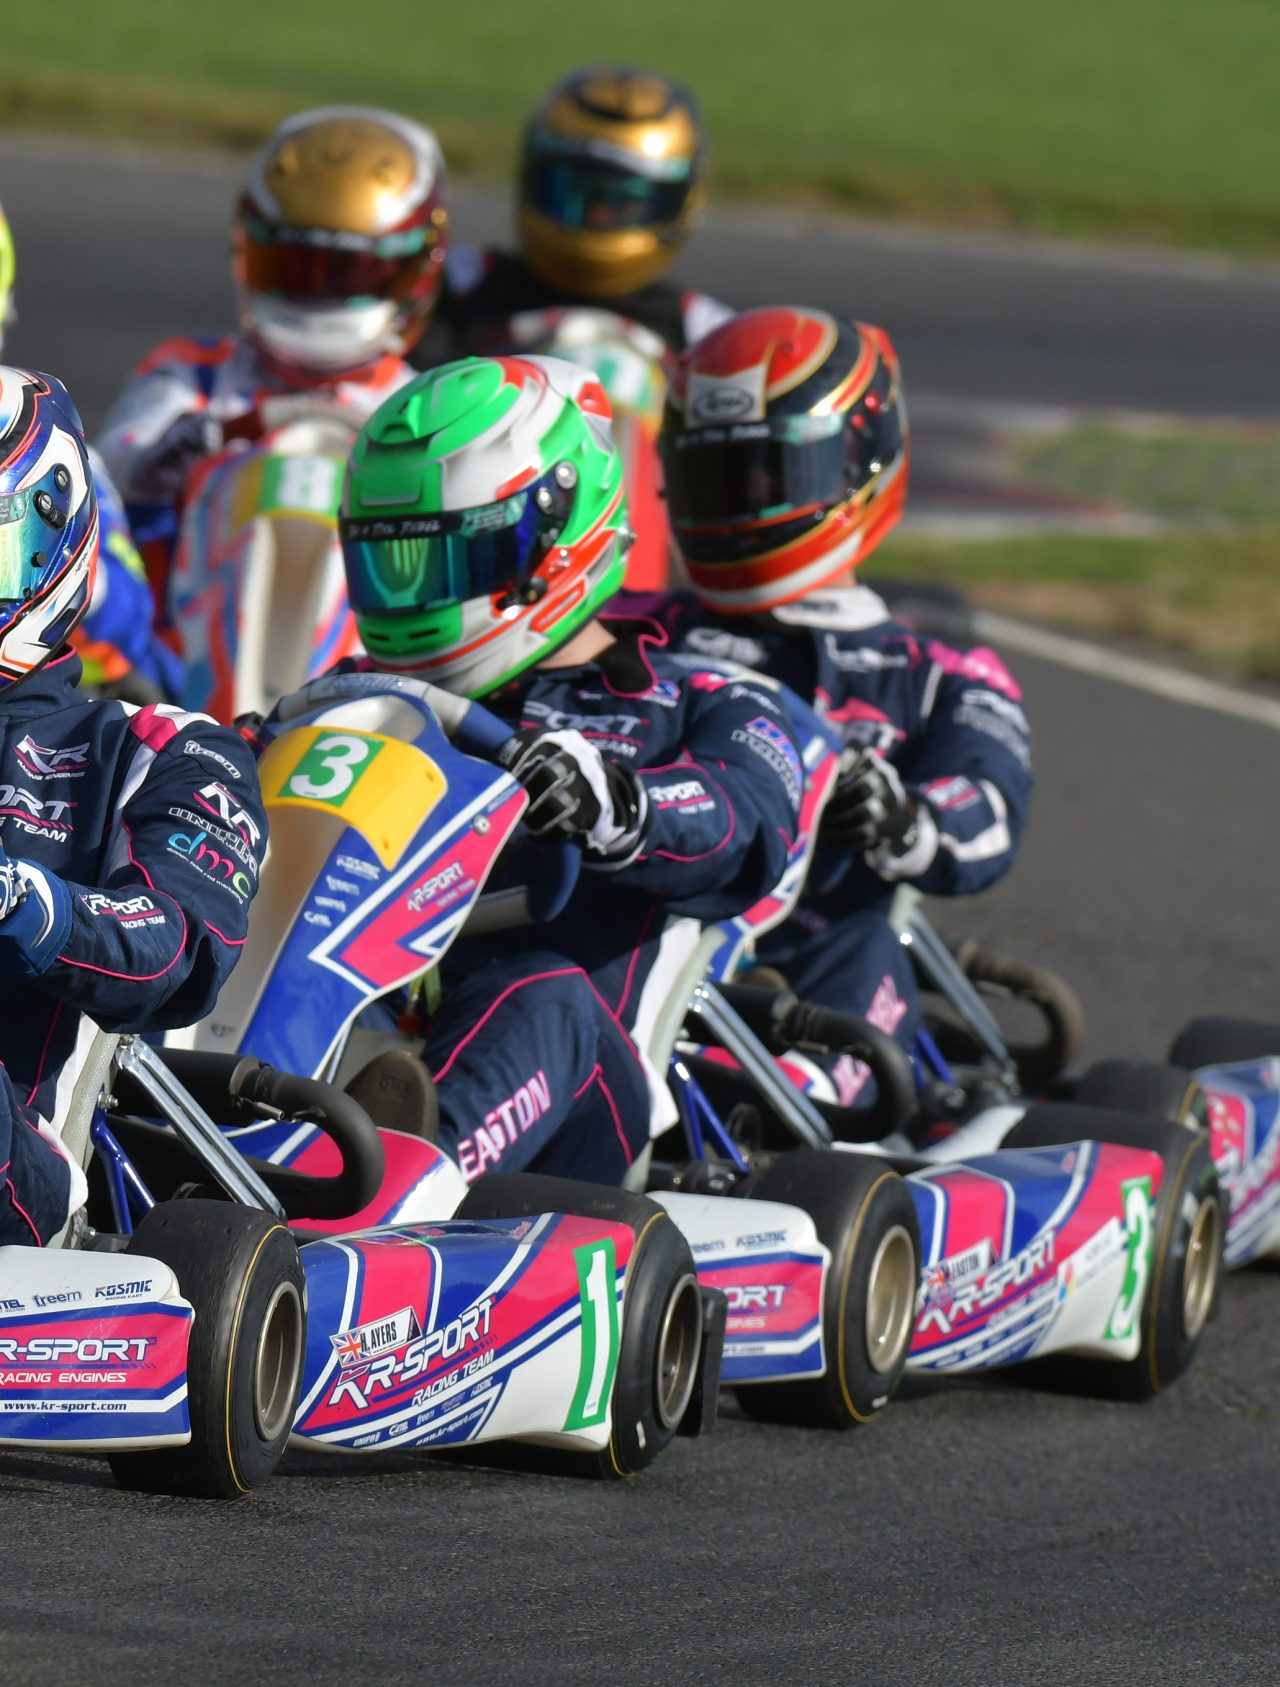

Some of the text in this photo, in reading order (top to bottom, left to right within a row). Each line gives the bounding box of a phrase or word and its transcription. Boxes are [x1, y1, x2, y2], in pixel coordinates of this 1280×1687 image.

[16, 734, 91, 774] KR
[289, 735, 369, 799] 3
[13, 817, 68, 843] TEAM
[168, 831, 251, 898] dmc
[457, 1067, 551, 1184] EASTON
[32, 1291, 82, 1307] freem
[95, 1280, 153, 1298] KOSMIC
[360, 1321, 397, 1351] H. AYERS
[581, 1248, 611, 1419] 1
[327, 1298, 493, 1410] KR-SPORT
[58, 1372, 127, 1383] ENGINES
[411, 1369, 459, 1407] RACING
[463, 1349, 495, 1378] TEAM
[4, 1401, 127, 1412] www.kr-sport.com
